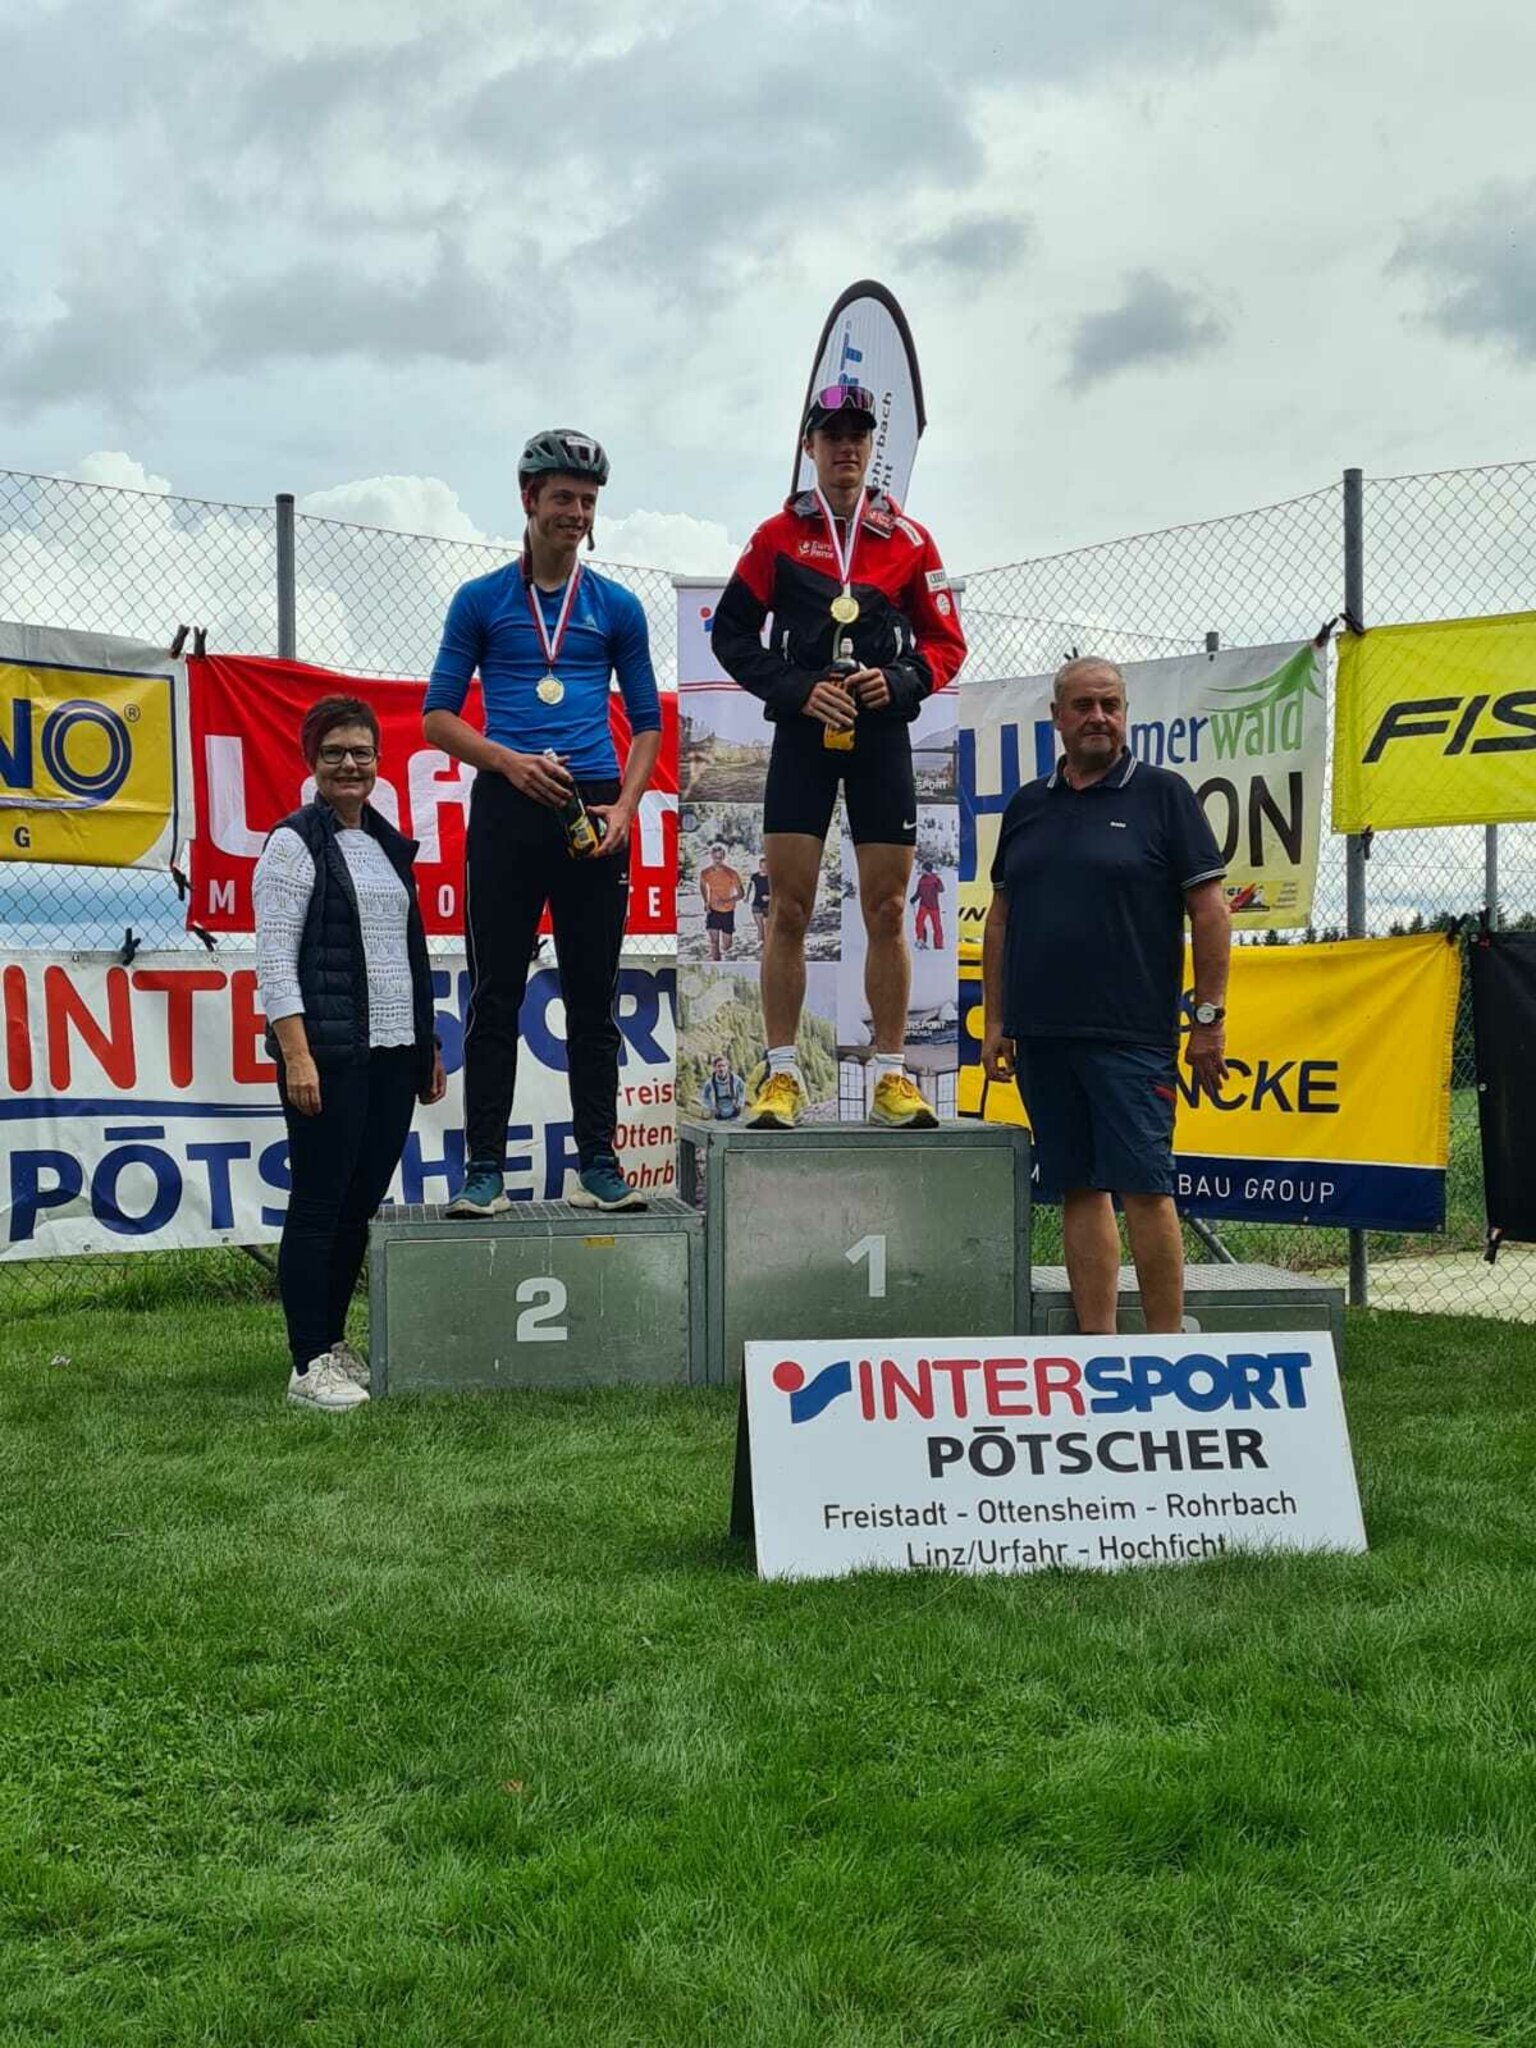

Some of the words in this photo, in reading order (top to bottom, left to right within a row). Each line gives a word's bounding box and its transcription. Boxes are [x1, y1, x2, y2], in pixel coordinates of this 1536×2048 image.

[871, 391, 892, 489] ohrbach
[1131, 694, 1303, 766] merwald
[613, 1123, 677, 1149] Otten
[617, 1160, 674, 1189] ohrb
[1244, 1178, 1335, 1204] GROUP
[845, 1235, 887, 1297] 1
[516, 1277, 568, 1342] 2
[858, 1352, 1312, 1421] INTERSPORT
[824, 1502, 948, 1530] Freistadt
[978, 1497, 1136, 1524] Ottensheim
[1166, 1490, 1297, 1518] Rohrbach
[907, 1538, 1068, 1568] Linz/Urfahr
[1099, 1533, 1226, 1561] Hochficht
